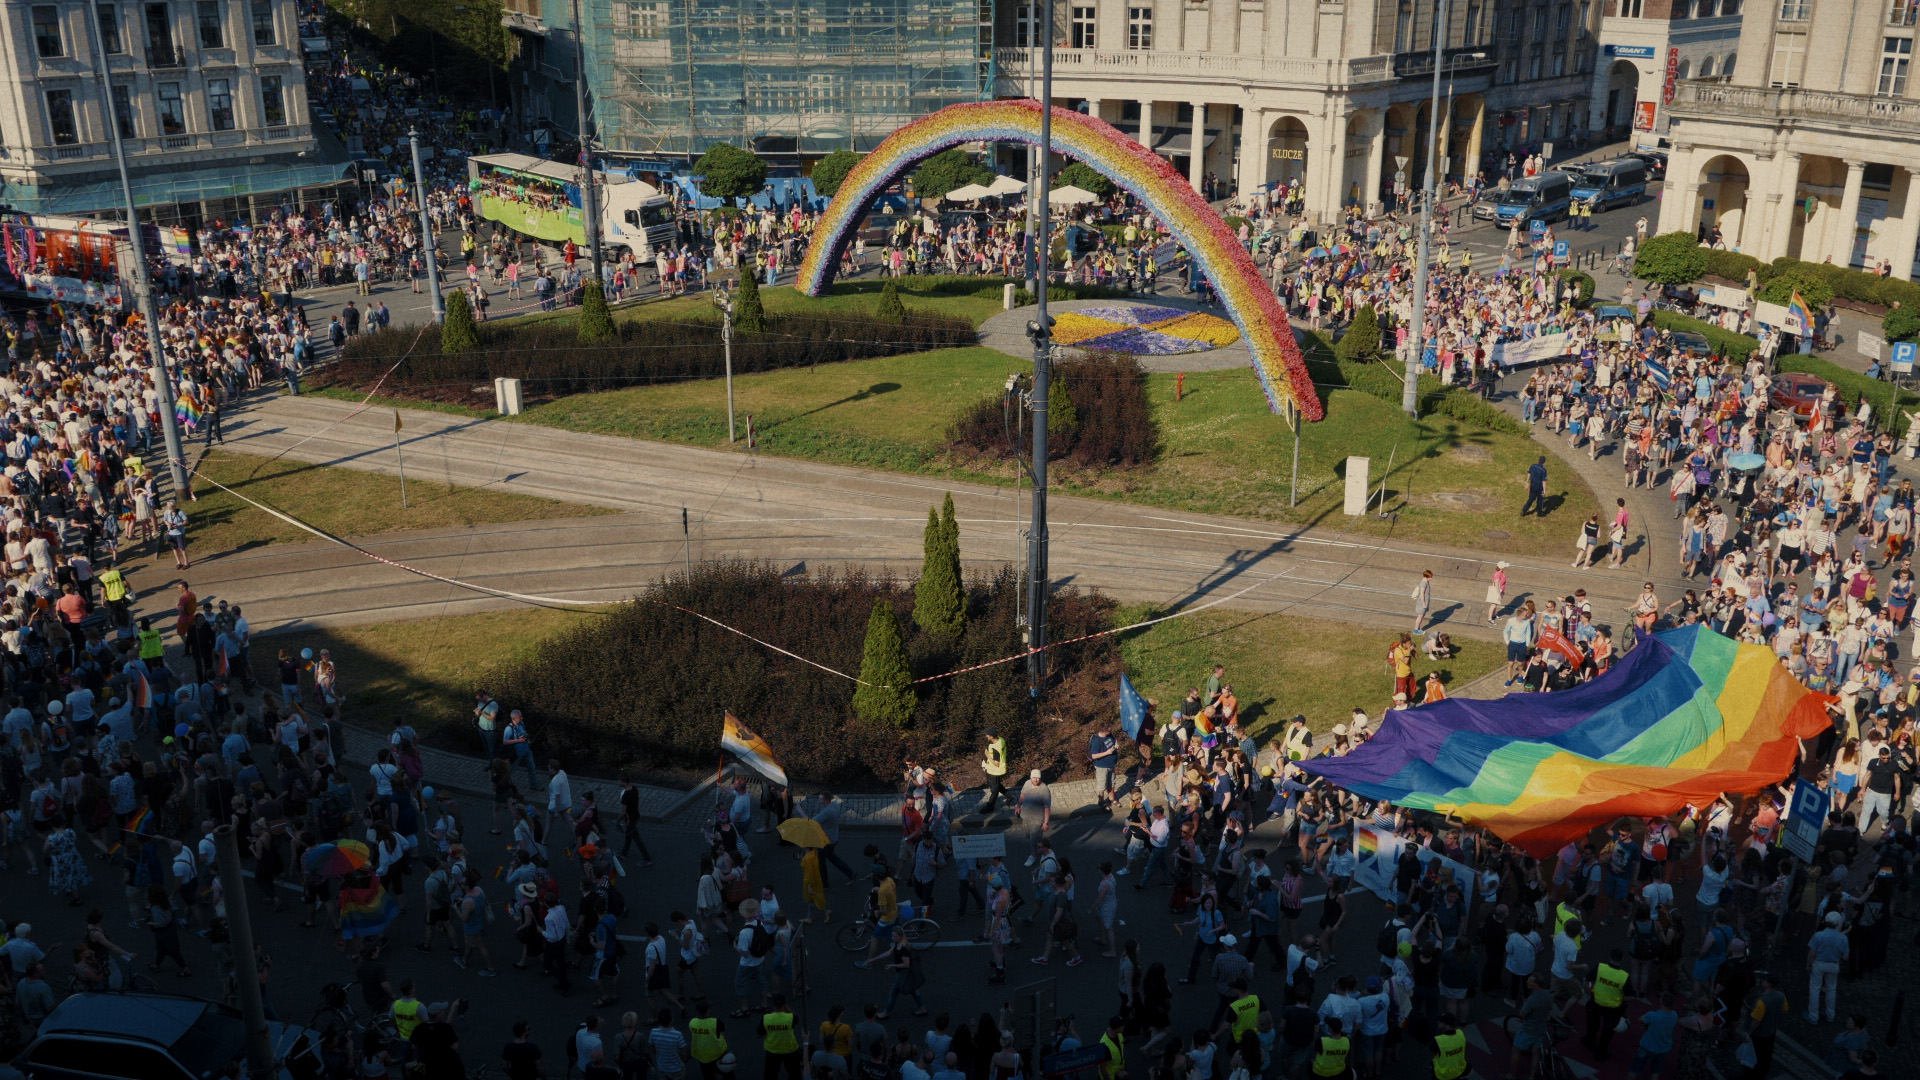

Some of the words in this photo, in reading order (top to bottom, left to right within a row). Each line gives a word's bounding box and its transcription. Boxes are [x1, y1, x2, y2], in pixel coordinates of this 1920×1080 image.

[1664, 48, 1679, 105] ROWERY
[1272, 149, 1303, 160] KLUCZE
[1556, 242, 1566, 255] P
[1897, 345, 1912, 360] P
[1797, 786, 1821, 814] P
[1599, 977, 1620, 988] POLICJA
[1238, 1002, 1256, 1012] POLICJA
[1445, 1047, 1463, 1057] POLICJA
[1055, 1053, 1096, 1070] Zbawiciela
